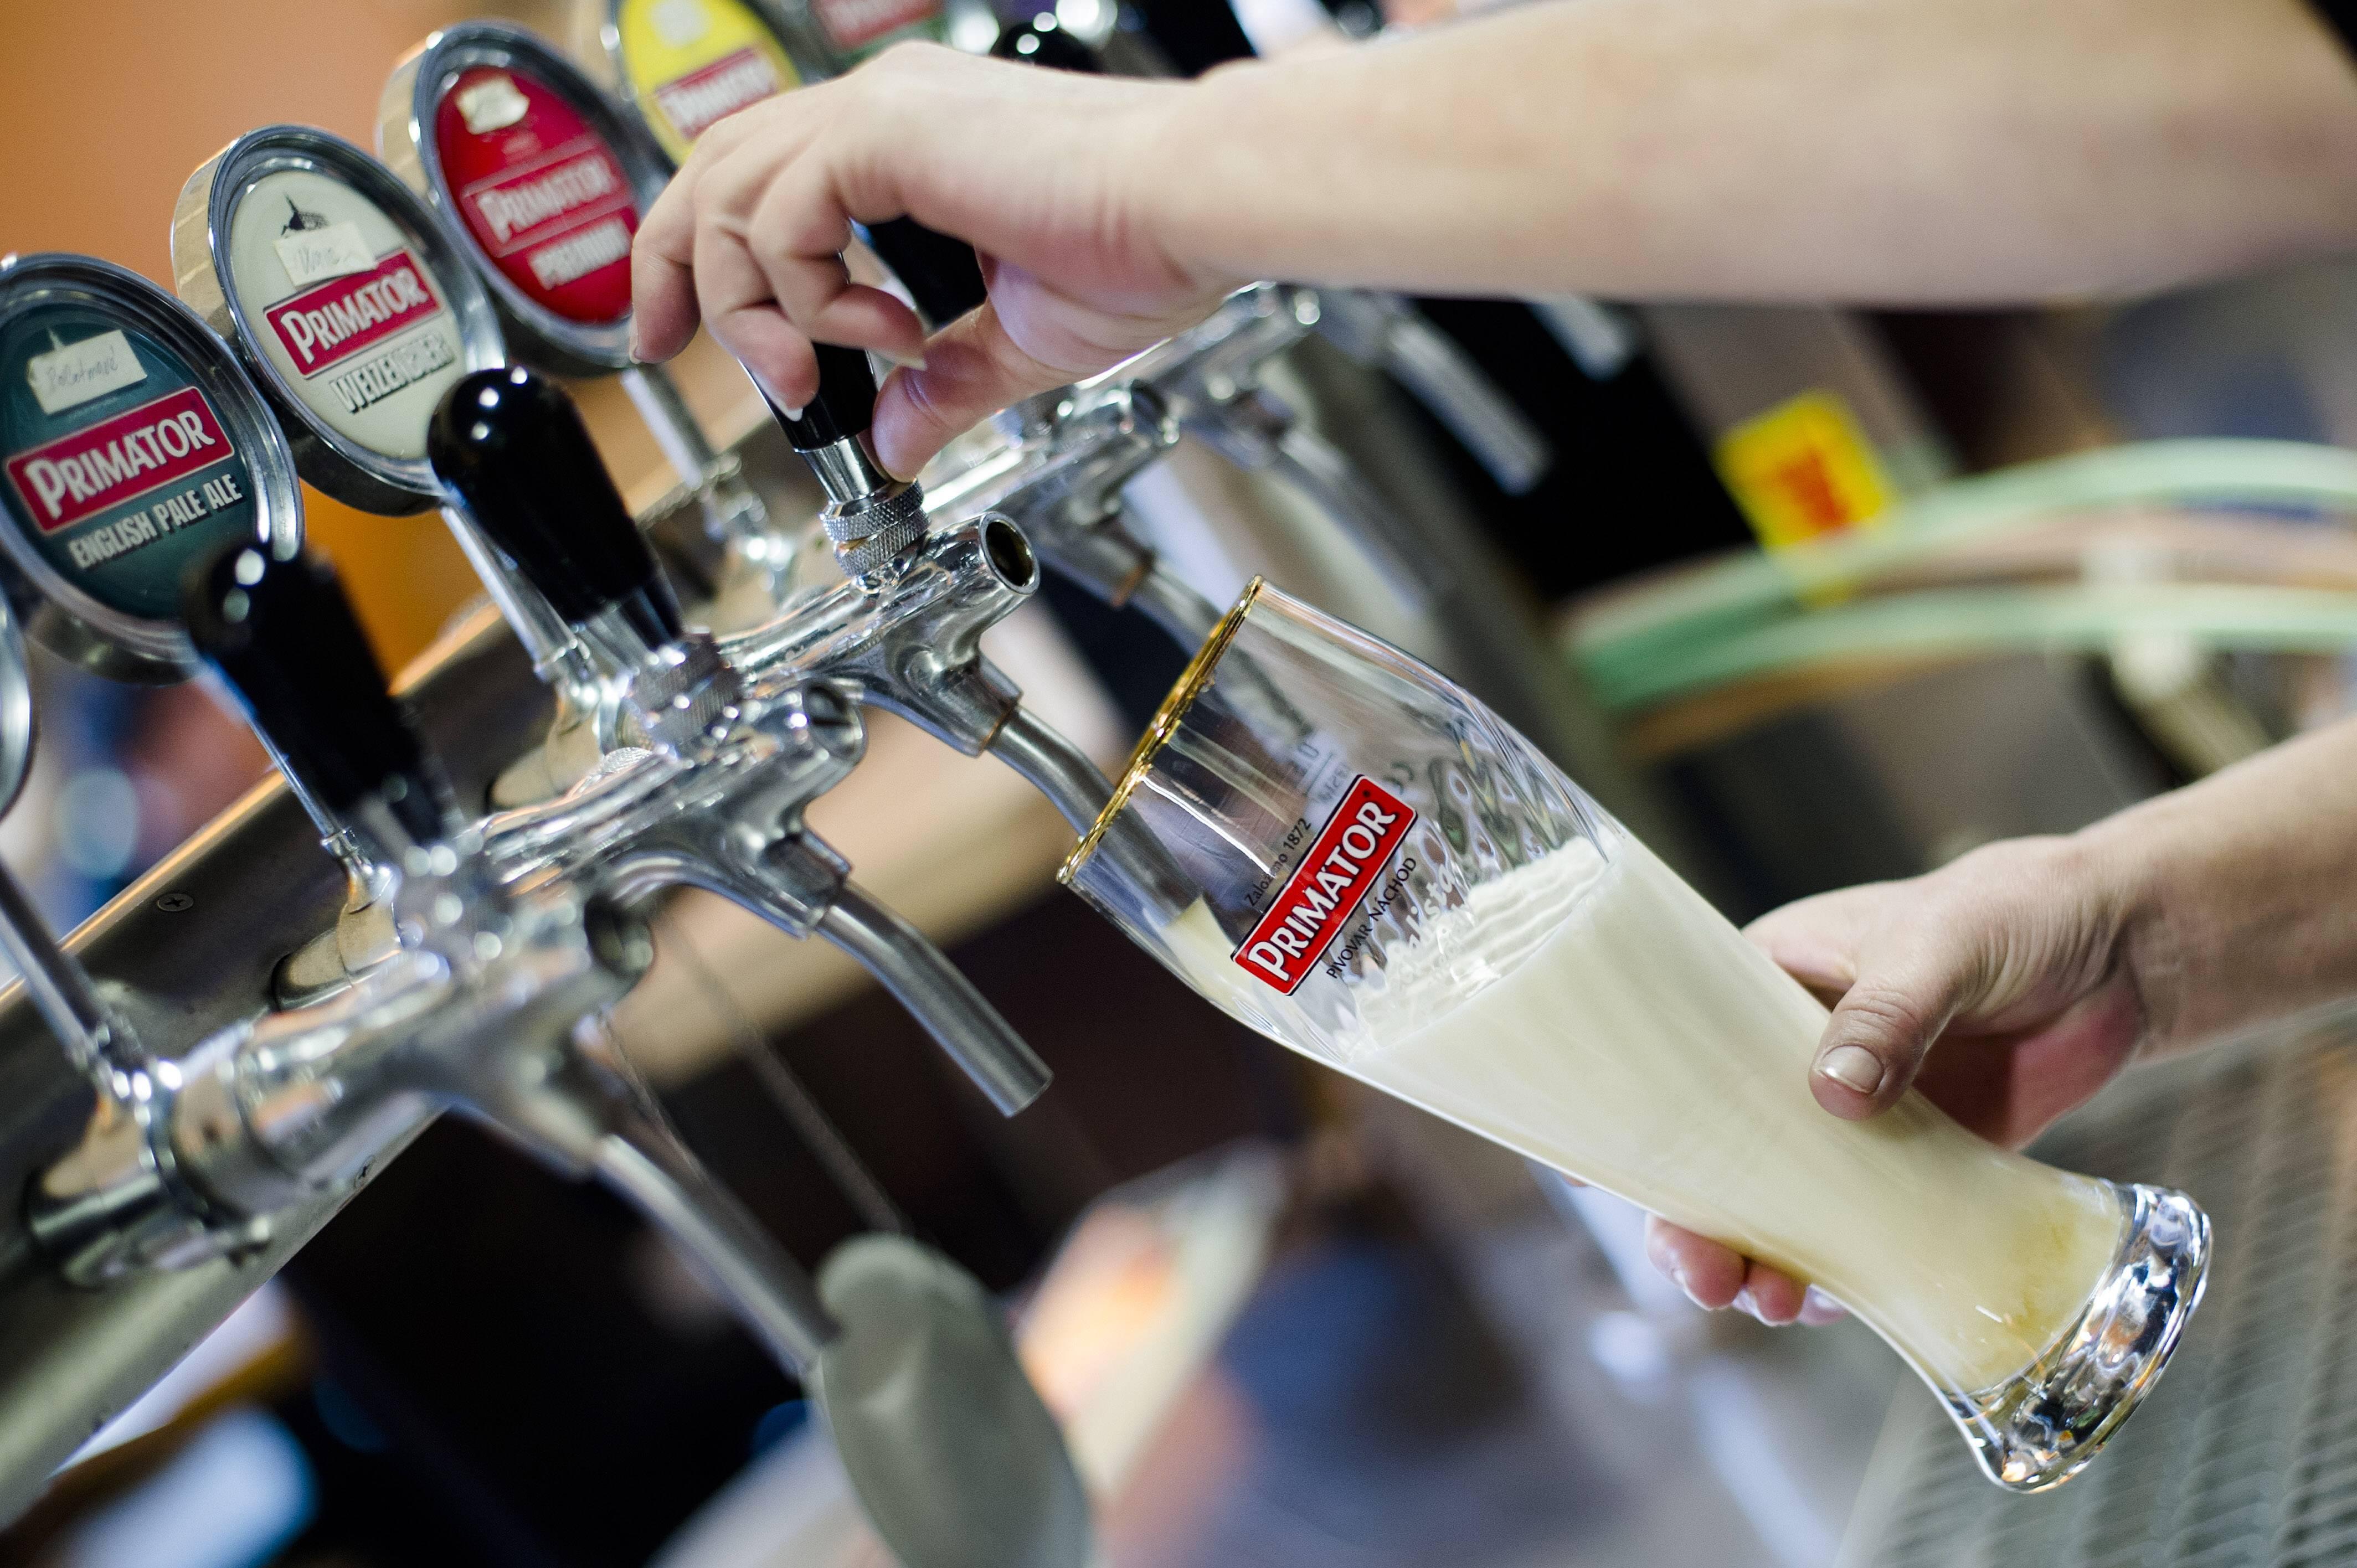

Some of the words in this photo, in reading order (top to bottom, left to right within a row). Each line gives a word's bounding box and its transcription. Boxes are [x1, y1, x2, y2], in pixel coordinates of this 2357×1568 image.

[68, 509, 158, 569] ENGLISH
[152, 488, 207, 533] PALE
[203, 473, 244, 510] ALE
[1283, 817, 1311, 850] 1872
[1326, 924, 1373, 979] PIVOVAR
[1368, 857, 1417, 921] NÁCHOD
